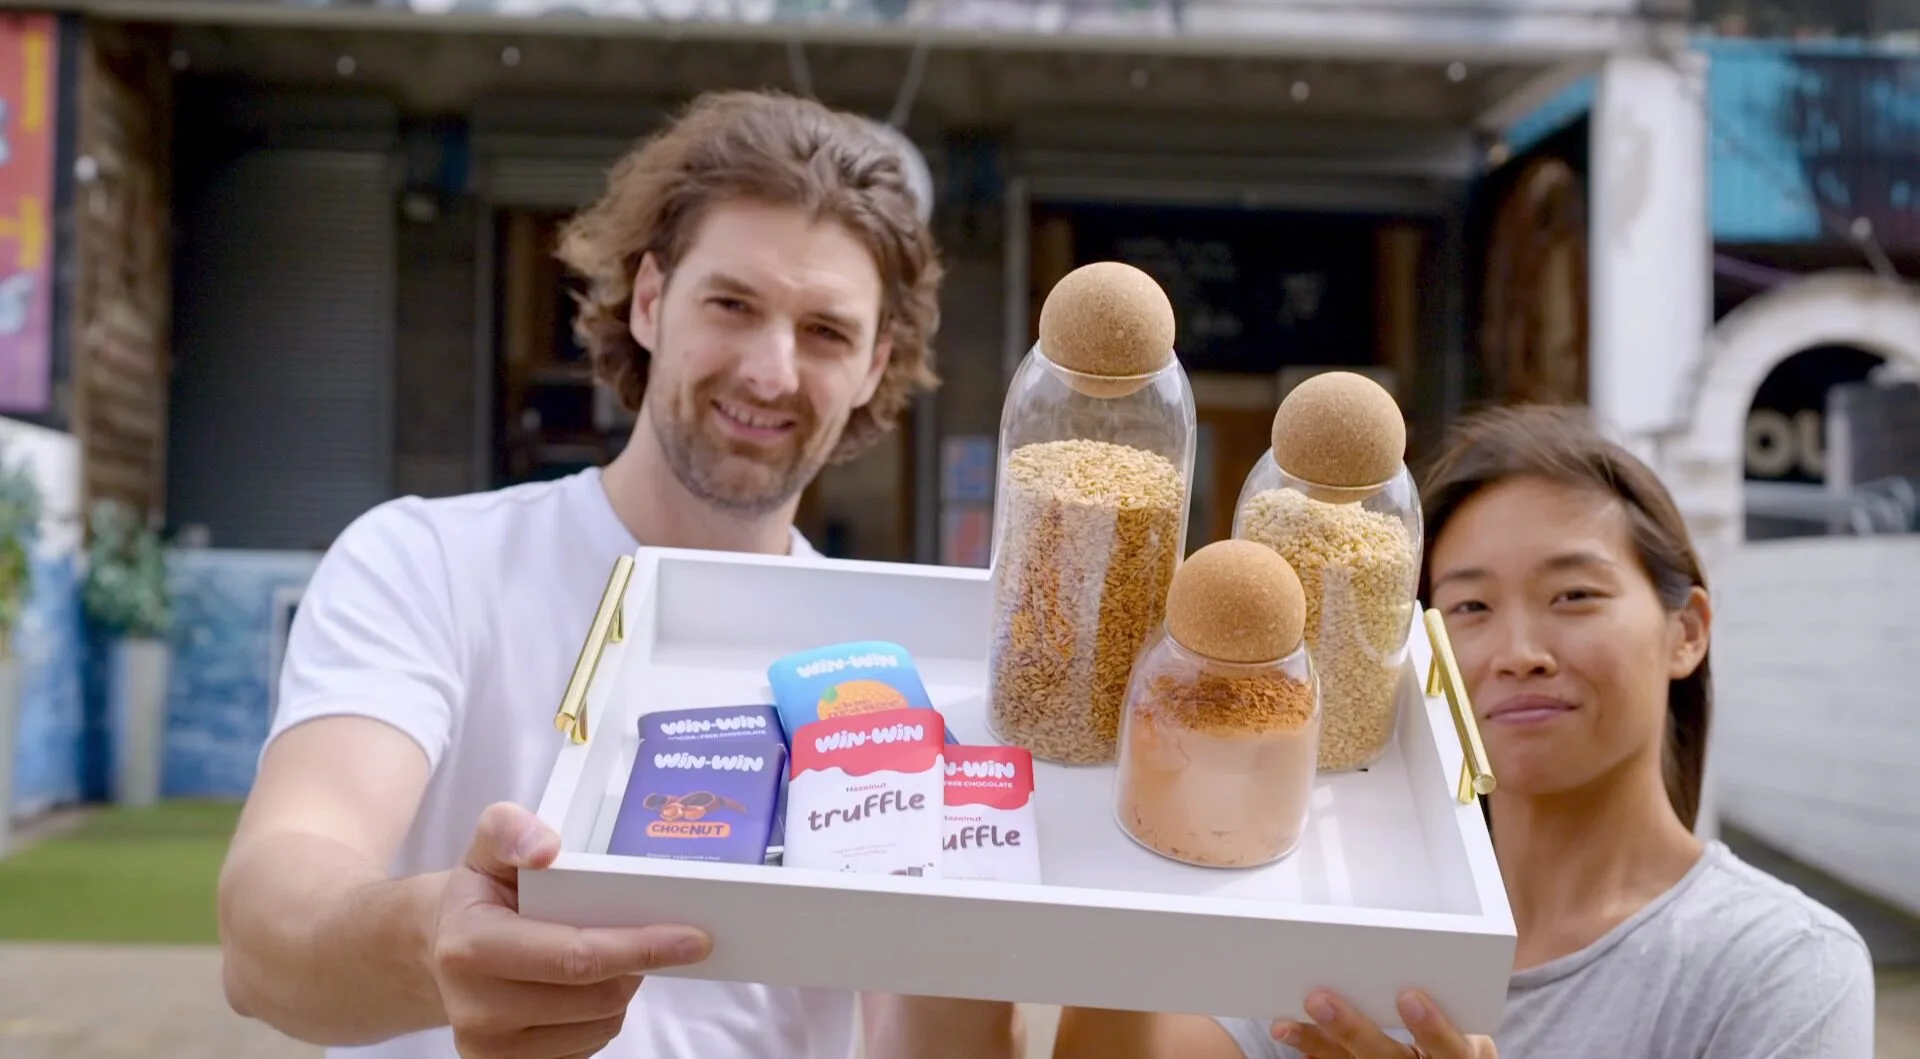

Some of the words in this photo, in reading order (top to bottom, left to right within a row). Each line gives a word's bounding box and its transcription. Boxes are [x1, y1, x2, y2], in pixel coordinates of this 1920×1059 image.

[963, 781, 1013, 789] CHOCOLATE
[651, 823, 725, 836] CHOCNUT
[943, 825, 1021, 850] uffle
